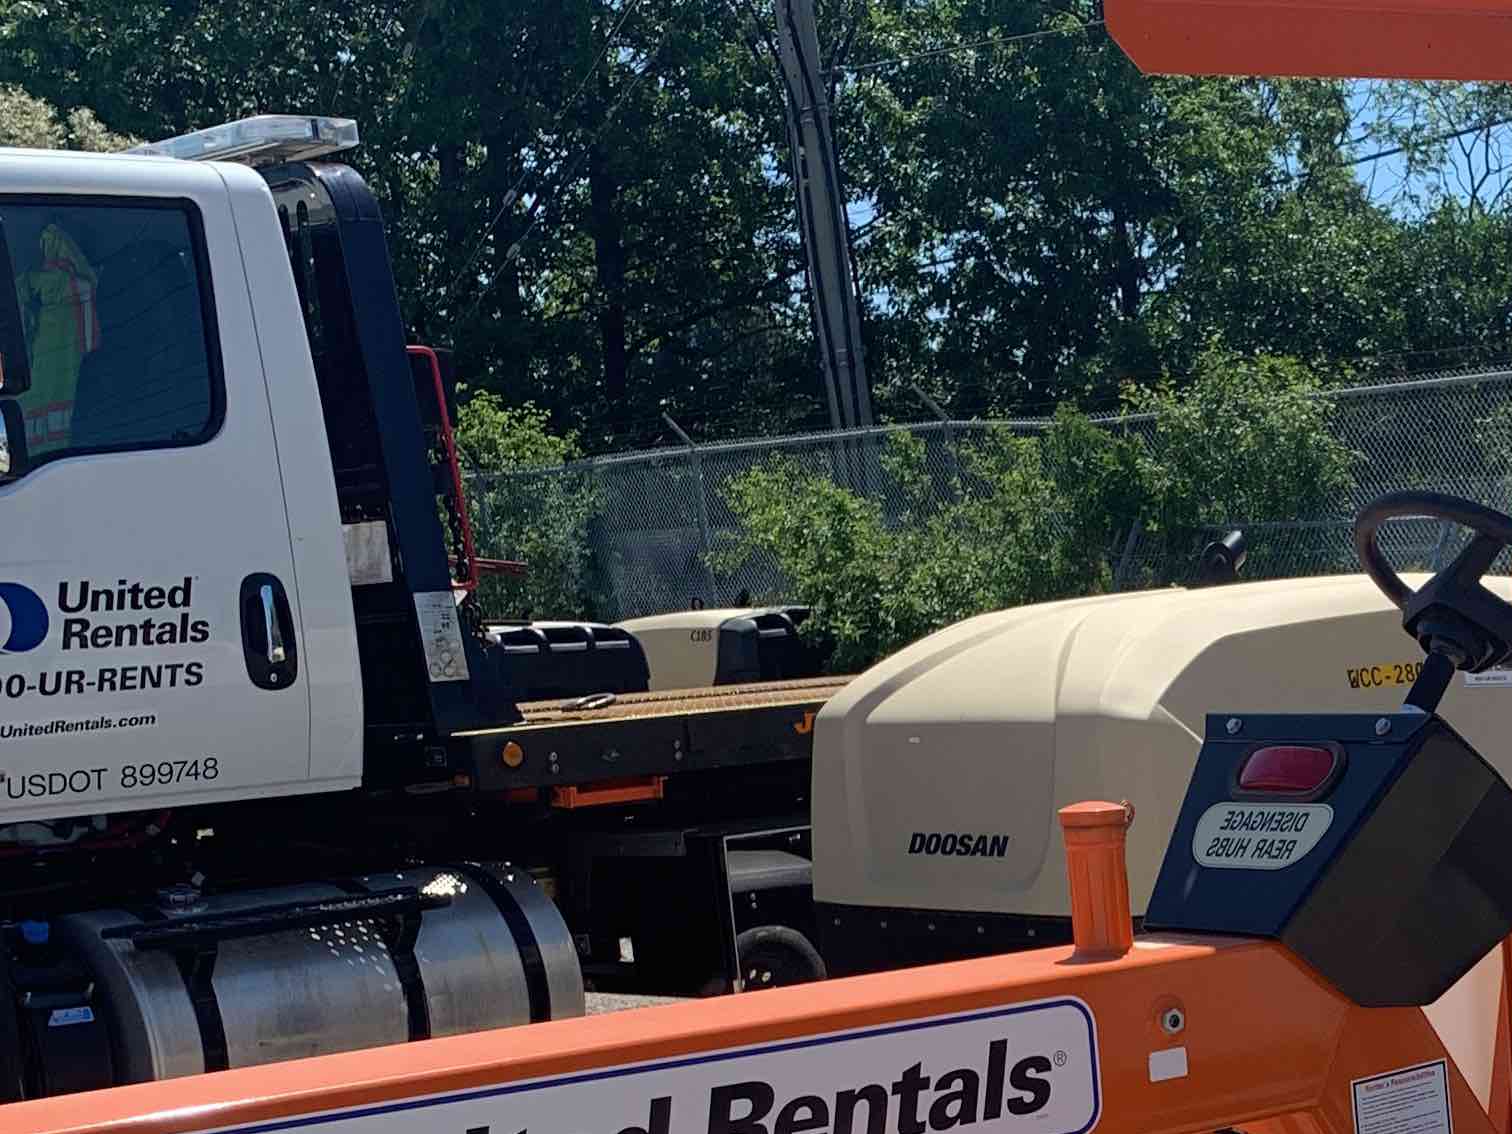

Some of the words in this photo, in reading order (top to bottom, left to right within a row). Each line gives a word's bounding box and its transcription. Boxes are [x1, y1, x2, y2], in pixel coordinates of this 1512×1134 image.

[58, 577, 192, 613] United
[62, 613, 209, 650] Rentals
[0, 663, 203, 698] 0-UR-RENTS
[0, 713, 156, 738] UnitedRentals.com
[7, 768, 108, 799] USDOT
[120, 758, 218, 788] 899748
[908, 831, 1009, 857] DOOSAN
